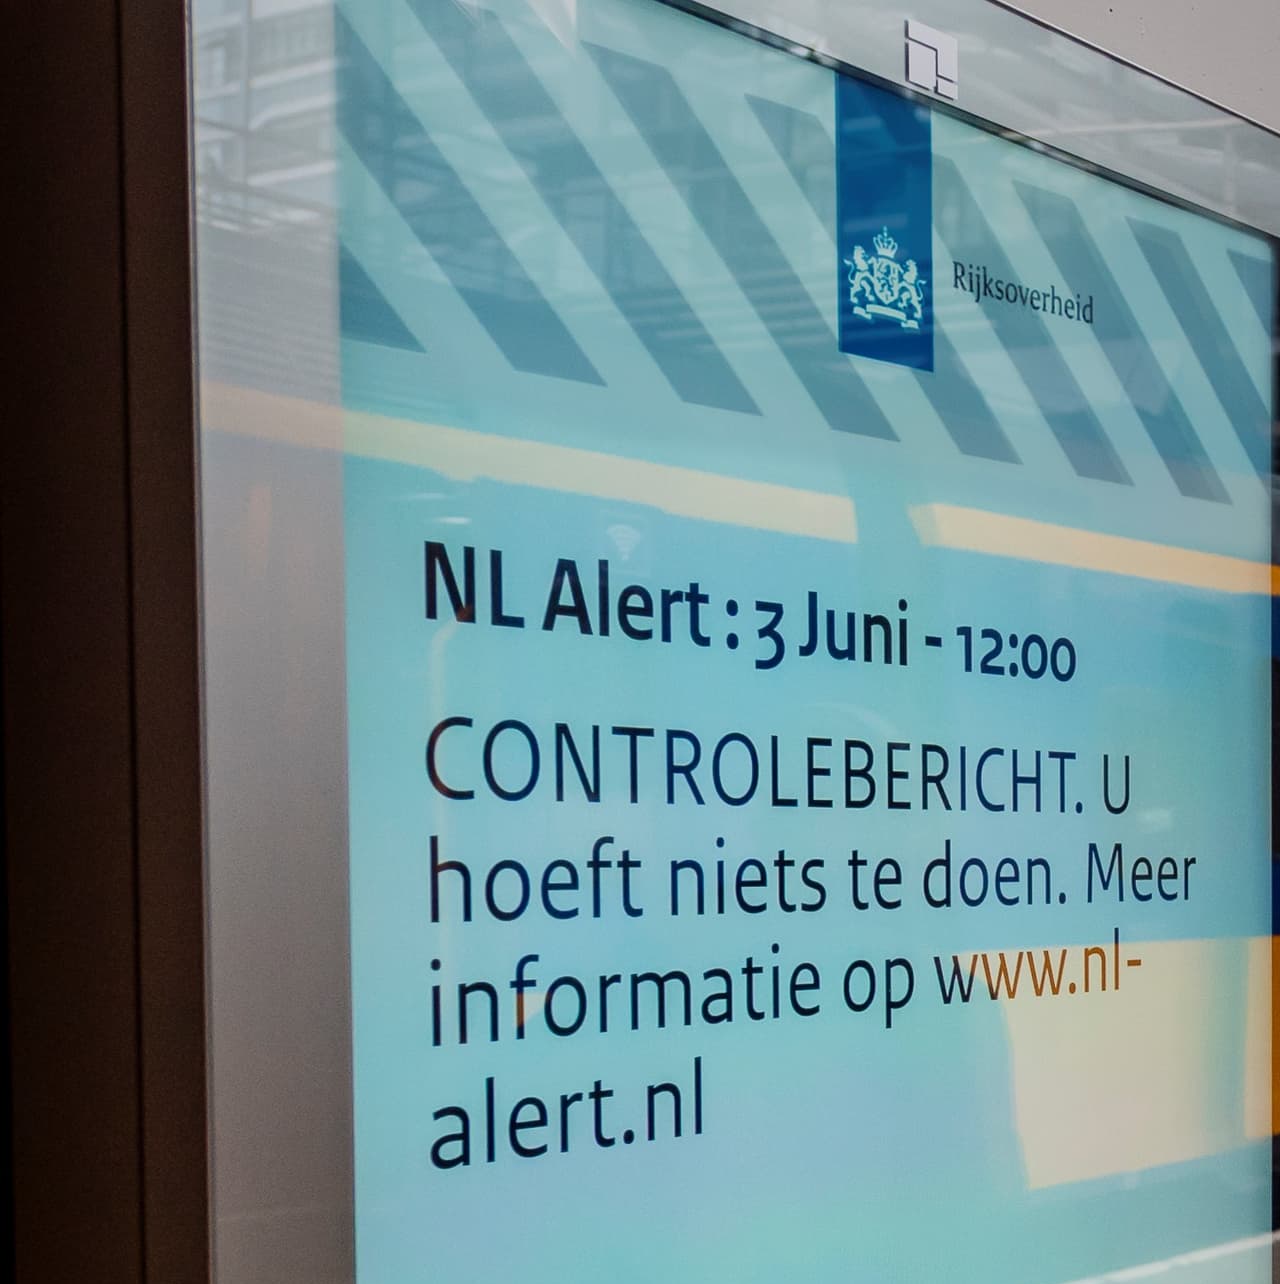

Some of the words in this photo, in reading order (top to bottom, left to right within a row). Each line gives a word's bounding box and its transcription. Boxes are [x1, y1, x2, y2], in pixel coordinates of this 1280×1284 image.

[952, 261, 1094, 325] Rijksoverheid
[424, 540, 525, 629] NL
[798, 590, 908, 667] Juni
[956, 625, 1077, 683] 12:00
[425, 716, 1083, 814] CONTROLEBERICHT.
[1103, 754, 1130, 815] U
[429, 835, 644, 923] hoeft
[670, 836, 827, 916] niets
[847, 849, 902, 911] te
[923, 838, 1067, 909] doen.
[1087, 842, 1197, 904] Meer
[430, 942, 821, 1047] informatie
[843, 957, 915, 1029] op
[933, 926, 1142, 1005] www.nl-
[430, 1055, 704, 1170] alert.nl
